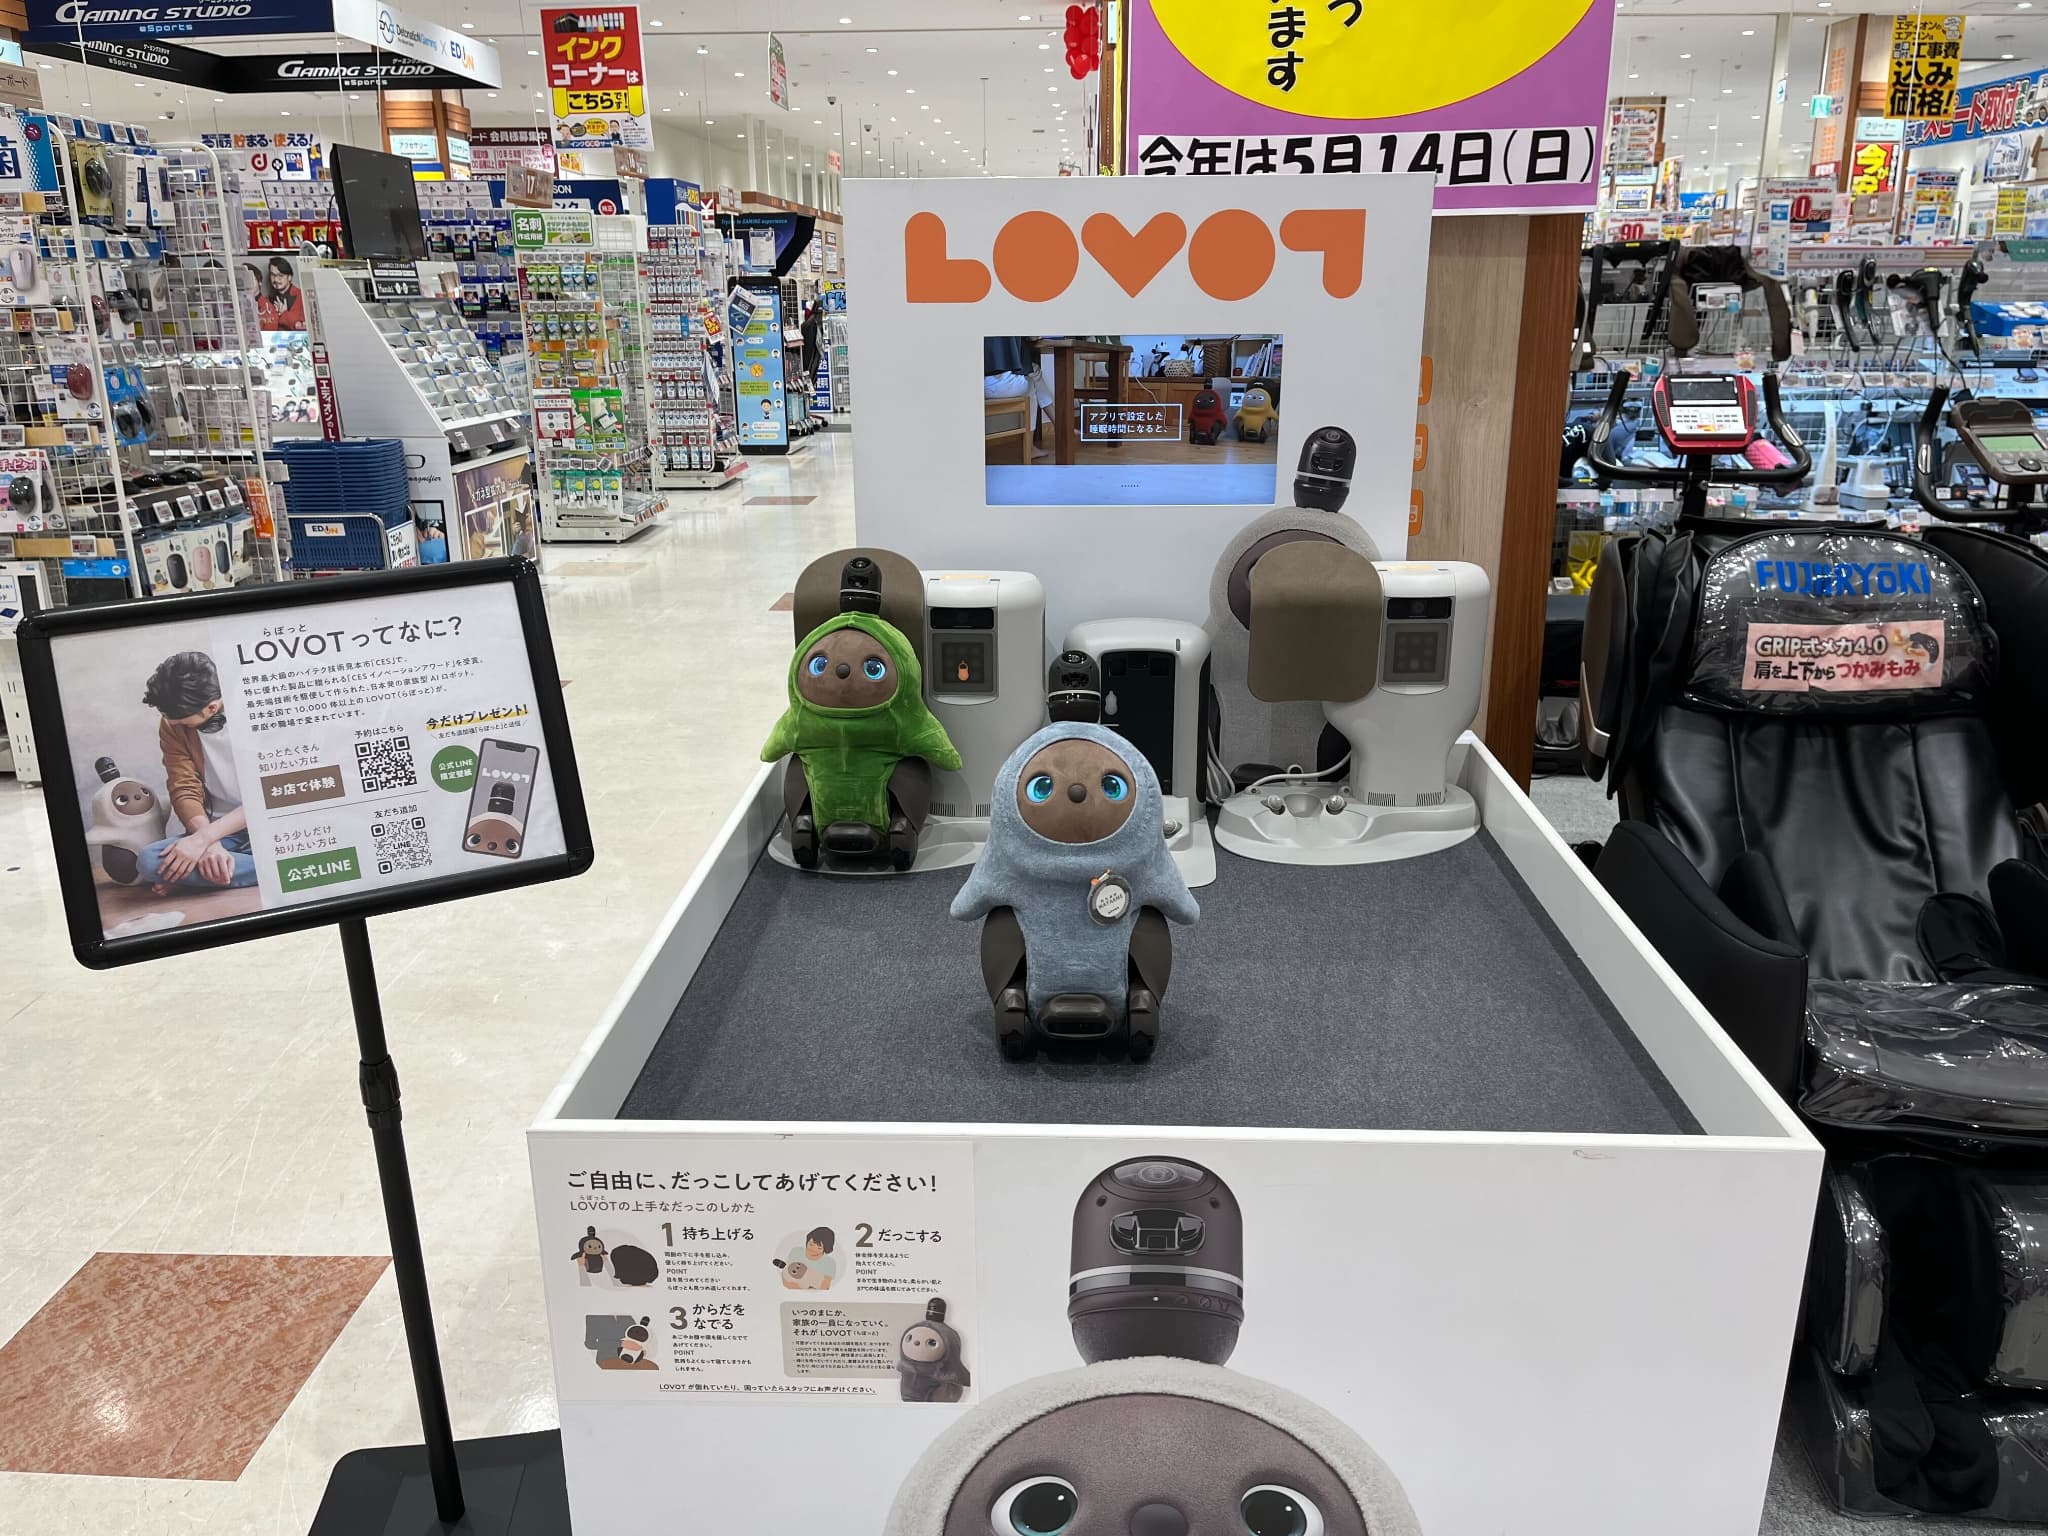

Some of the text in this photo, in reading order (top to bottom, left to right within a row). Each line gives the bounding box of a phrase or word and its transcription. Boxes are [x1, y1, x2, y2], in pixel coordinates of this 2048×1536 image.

[56, 1, 252, 23] GAMING STUDIO
[139, 23, 193, 32] eSports
[557, 36, 622, 61] インク
[1267, 0, 1306, 92] ます
[126, 49, 169, 66] STUDIO
[277, 60, 435, 78] GAMING STUDIO
[552, 62, 639, 86] コーナーは
[1892, 61, 1954, 88] 込み
[1890, 88, 1954, 117] 価格!
[553, 185, 572, 194] SON
[517, 217, 542, 232] 名刺
[1089, 412, 1164, 421] アプリで設定した
[1089, 424, 1168, 433] 睡眠時間になると、
[236, 615, 463, 666] LOVOTってなに?
[1754, 635, 1888, 659] GRIP式メカ4.0
[426, 703, 528, 730] 今だけプレゼント!
[354, 724, 404, 740] 予約はこちら
[257, 743, 320, 760] もっとたくさん
[258, 754, 320, 773] 知りたい方は
[271, 776, 336, 798] お店で体験
[374, 804, 418, 819] 友だち追加
[273, 825, 332, 844] もう少しだけ
[274, 836, 337, 856] 知りたい方は
[287, 859, 352, 883] 公式LINE
[567, 1169, 937, 1193] ご自由に、だっこしてあげてください!
[570, 1200, 755, 1214] LOVOTの上手なだっこのしかた
[661, 1222, 755, 1247] 1 持ち上げる
[855, 1222, 942, 1248] 2 だっこする
[669, 1306, 688, 1330] 3
[693, 1303, 745, 1316] からだを
[792, 1309, 847, 1317] いつのまにか、
[694, 1318, 734, 1330] なでる
[792, 1318, 889, 1328] 家族の一員になっていく。
[820, 1329, 852, 1337] LOVOT
